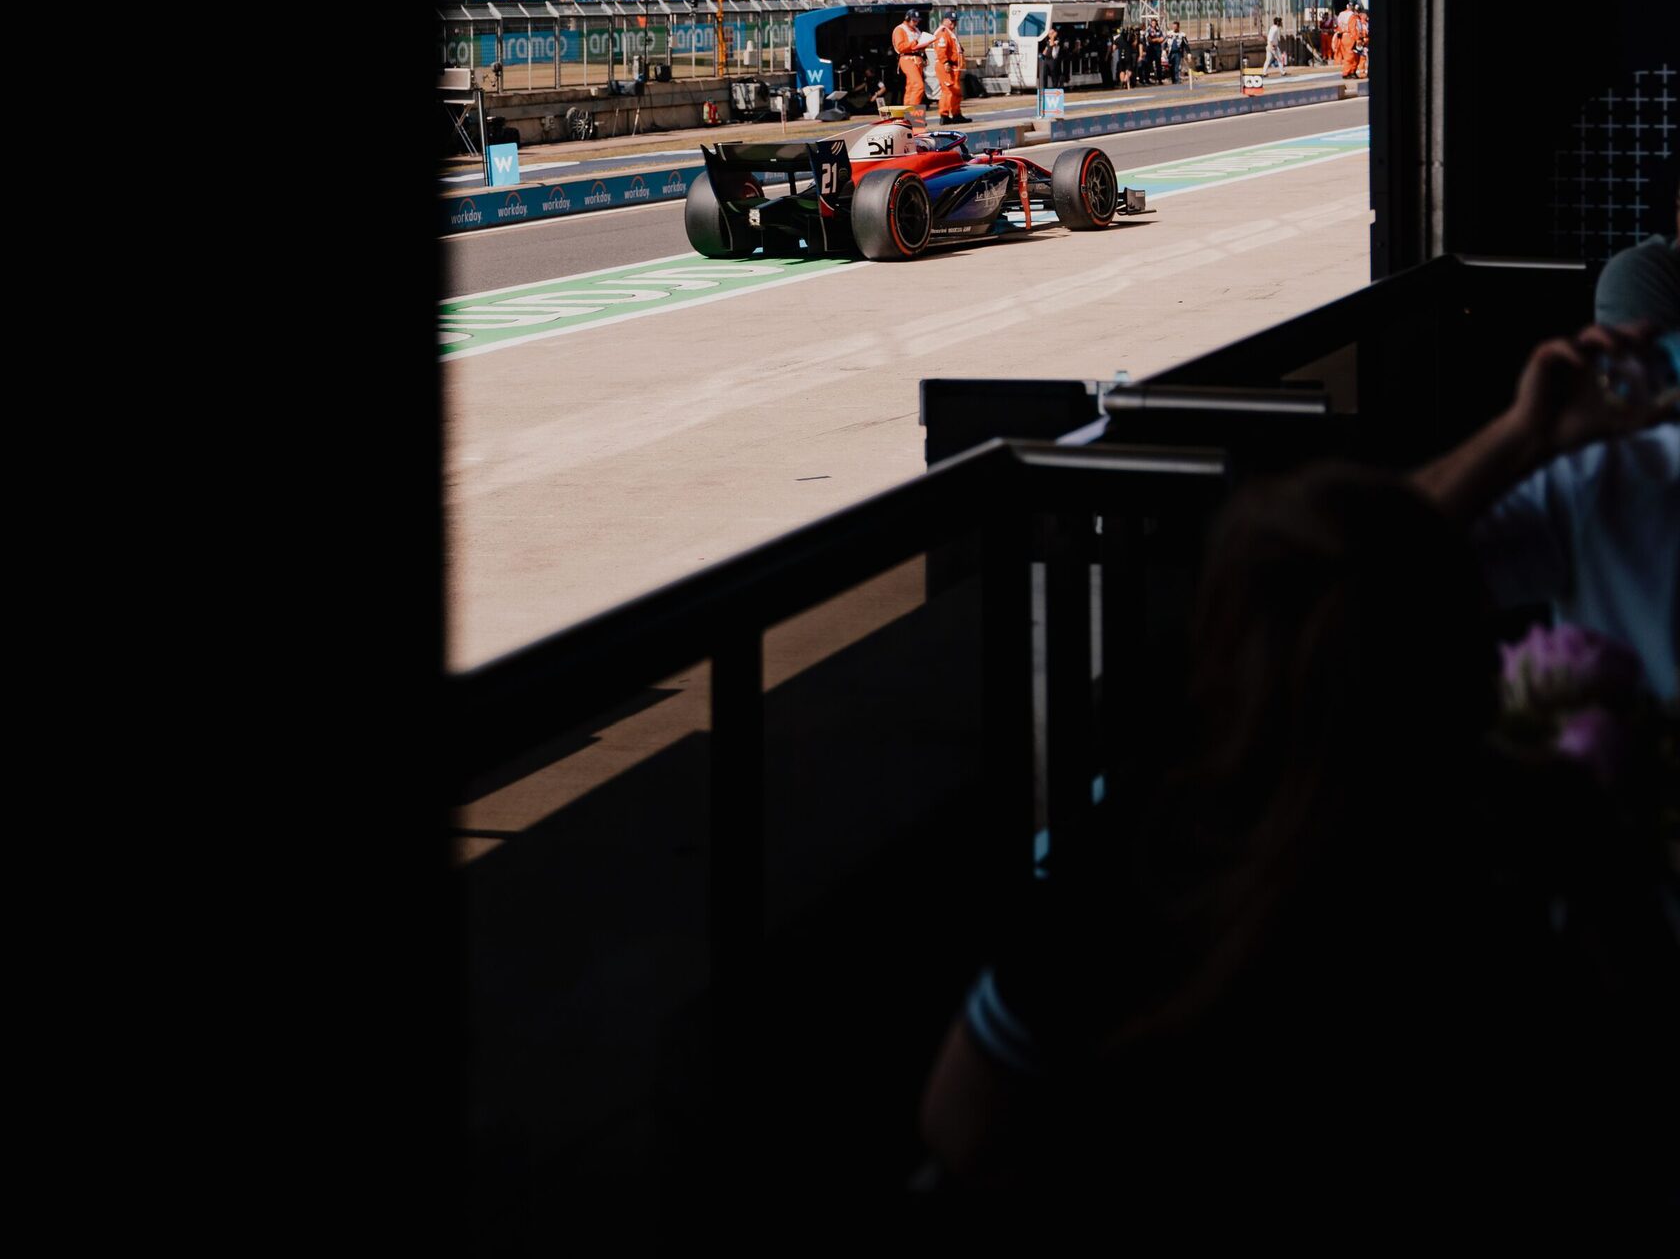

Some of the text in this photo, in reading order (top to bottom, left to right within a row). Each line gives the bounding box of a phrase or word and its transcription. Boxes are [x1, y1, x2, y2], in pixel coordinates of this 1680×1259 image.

[807, 69, 824, 84] W
[1046, 96, 1061, 109] W
[493, 155, 513, 174] W
[821, 162, 838, 195] 21
[542, 197, 571, 212] workday
[584, 191, 612, 205] workday
[497, 203, 528, 218] workday
